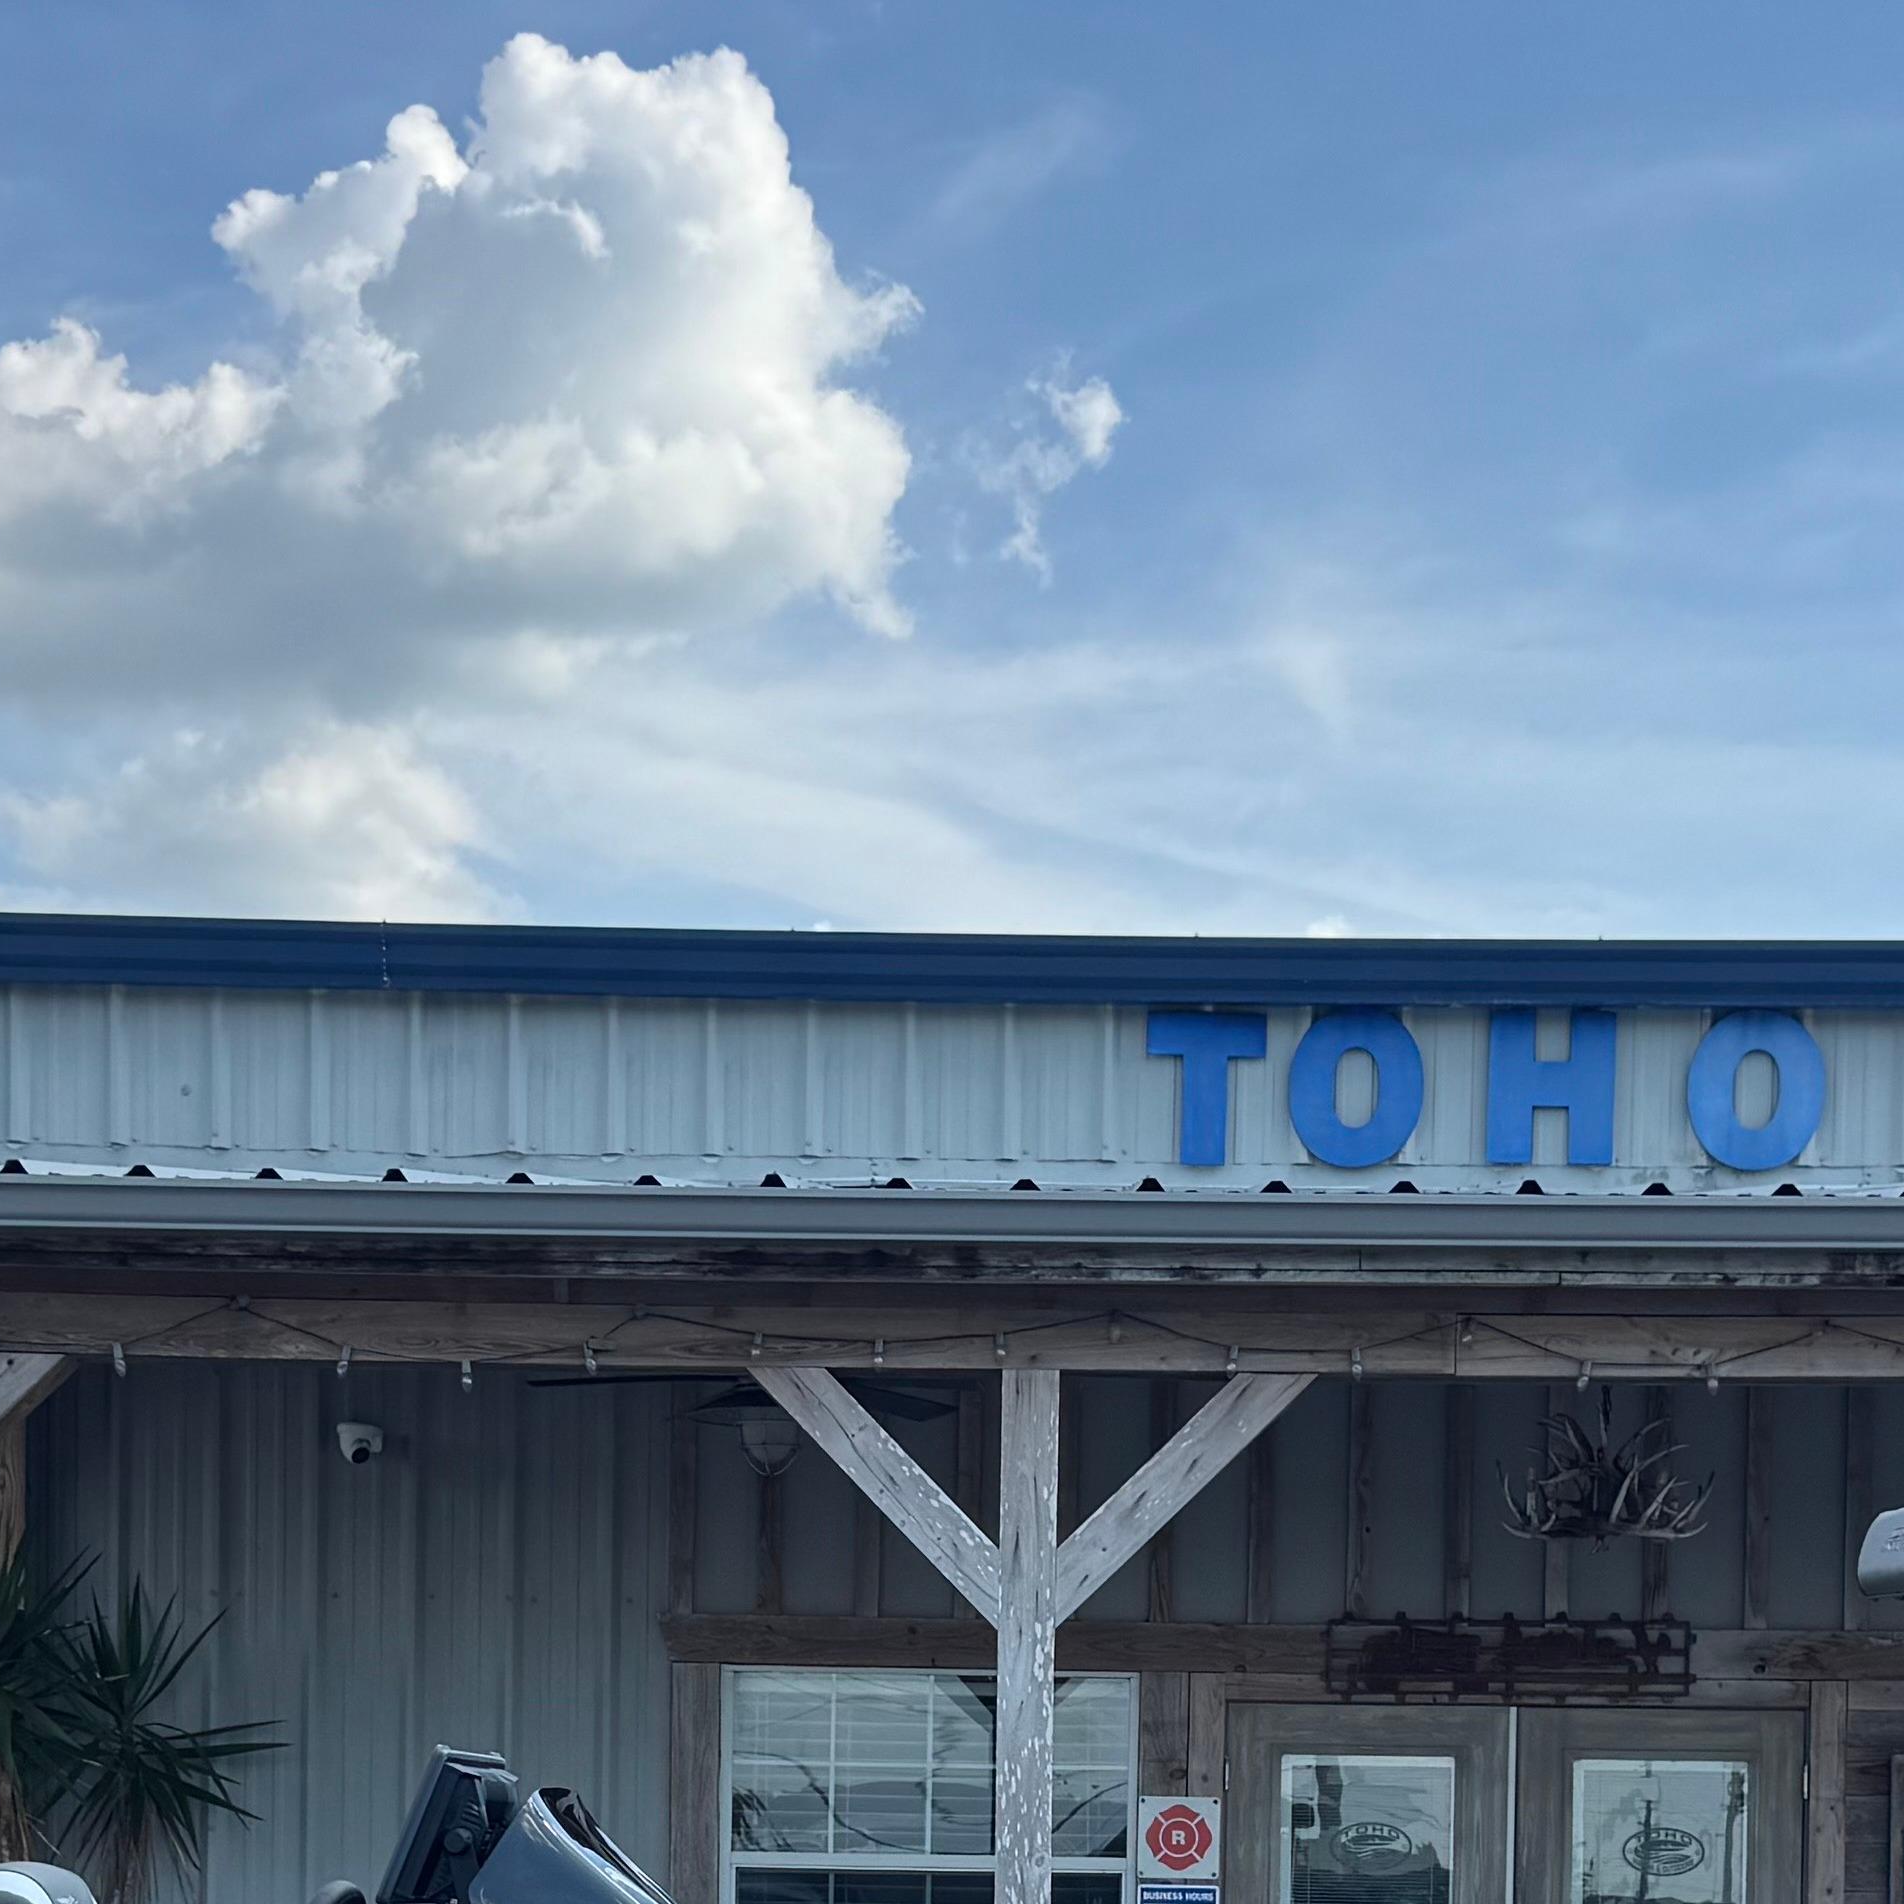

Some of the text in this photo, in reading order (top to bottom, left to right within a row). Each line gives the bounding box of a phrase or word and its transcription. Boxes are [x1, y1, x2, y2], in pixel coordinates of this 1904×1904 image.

[1148, 1009, 1825, 1171] TOHO
[1171, 1830, 1186, 1845] R
[1344, 1825, 1400, 1840] TOHO
[1143, 1891, 1214, 1902] BUSINESS HOURS
